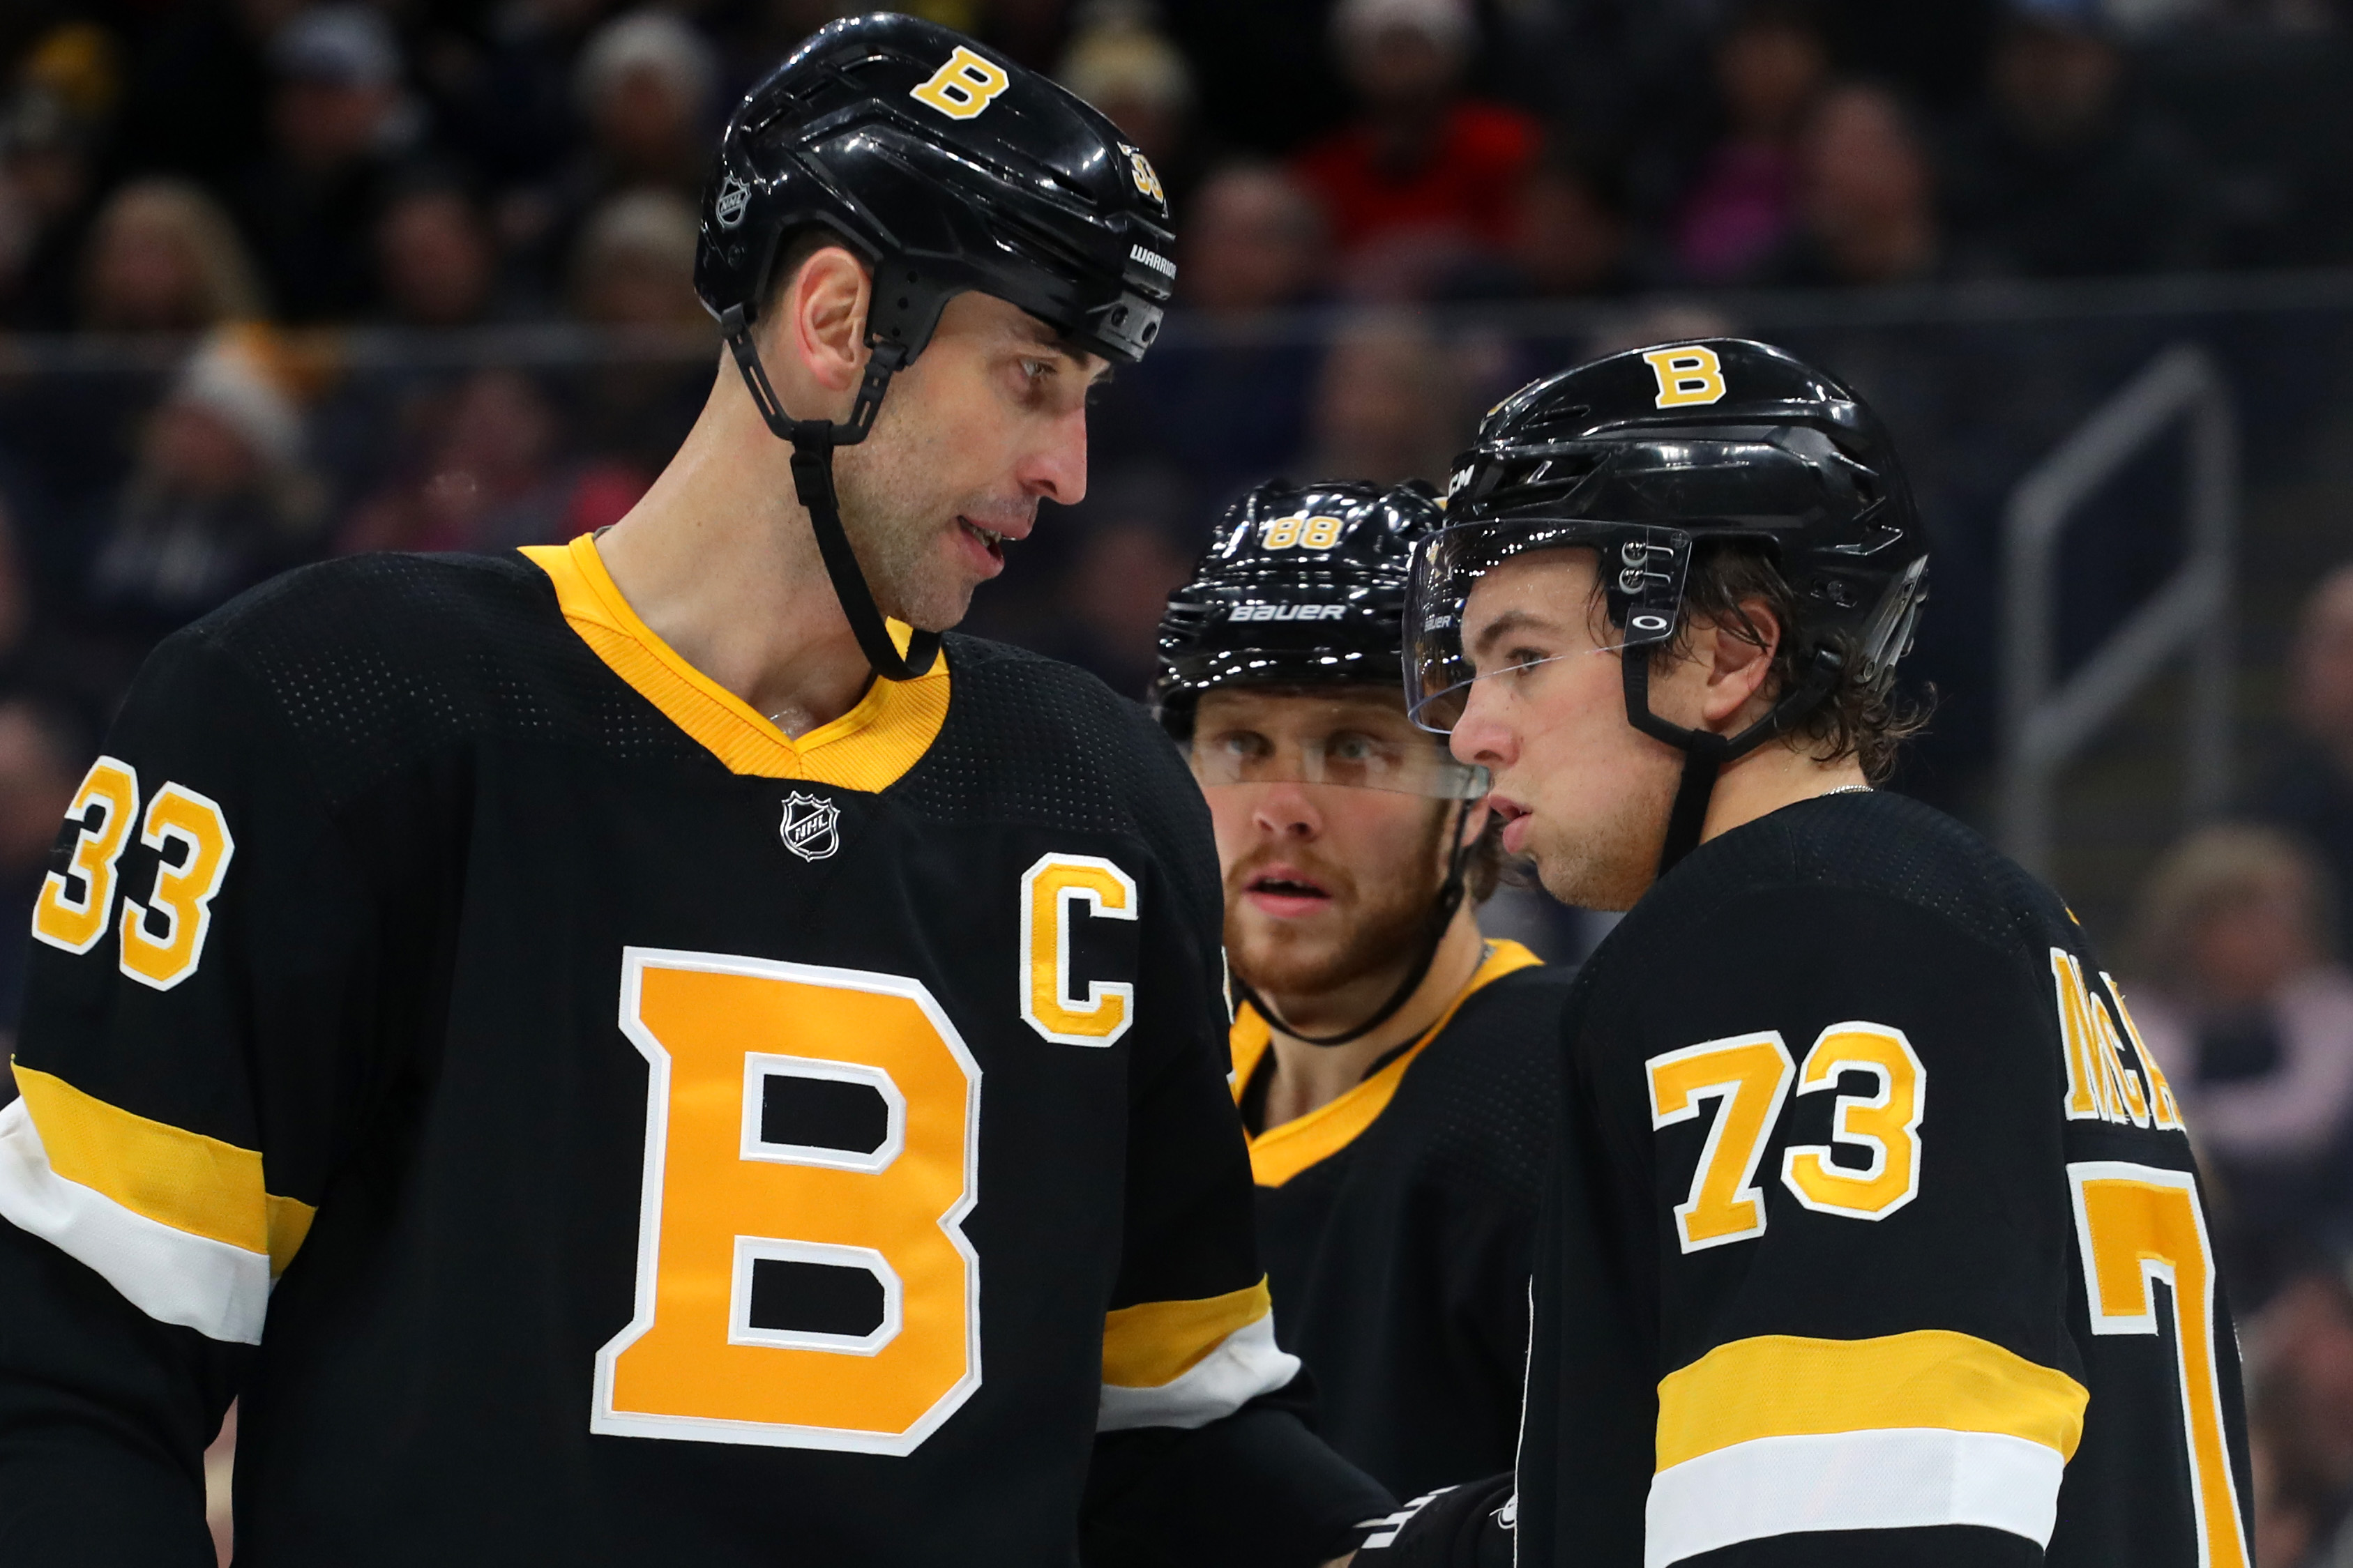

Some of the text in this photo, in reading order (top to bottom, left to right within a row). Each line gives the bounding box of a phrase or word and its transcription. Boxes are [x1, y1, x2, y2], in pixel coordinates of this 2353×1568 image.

[909, 45, 1010, 120] B
[1643, 345, 1726, 409] B
[1261, 515, 1345, 550] 88
[1227, 604, 1347, 621] BAUER
[795, 814, 828, 842] NHL
[31, 755, 235, 991] 33
[1020, 853, 1138, 1047] C
[1645, 1020, 1927, 1254] 73
[590, 945, 983, 1457] B
